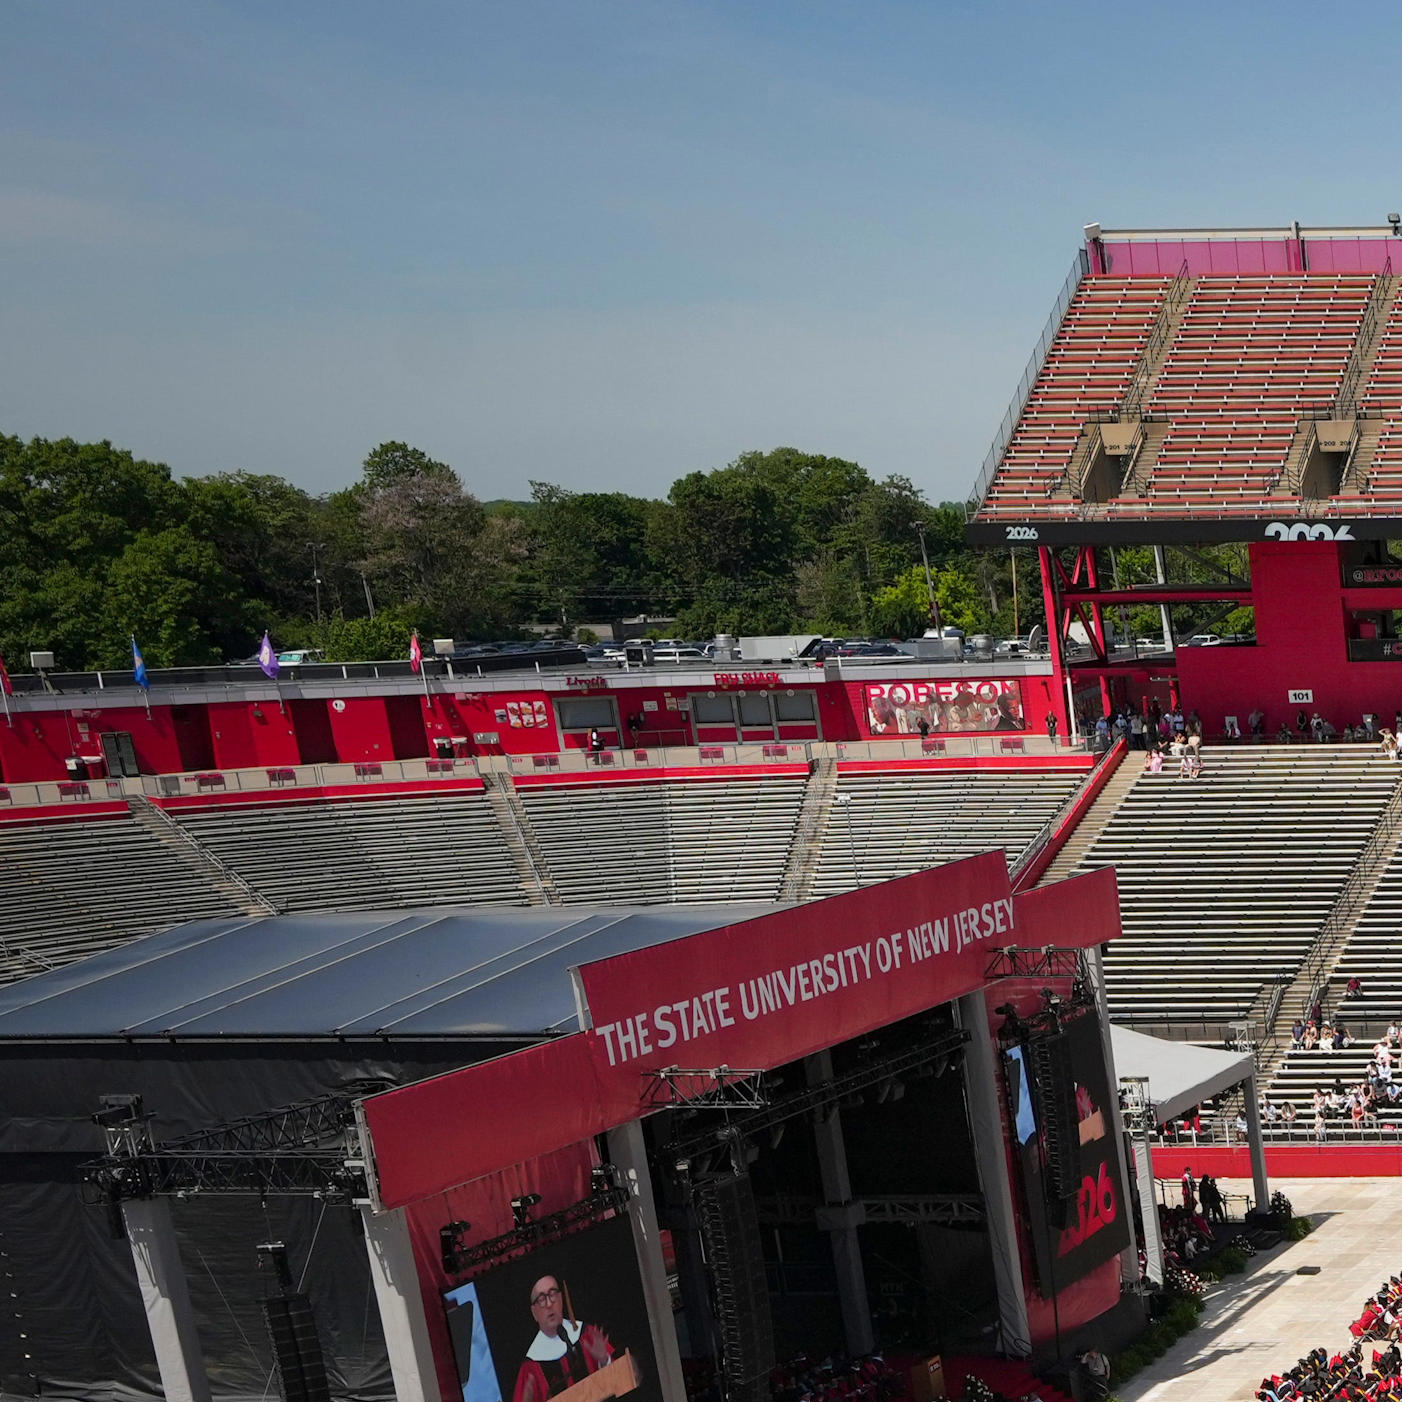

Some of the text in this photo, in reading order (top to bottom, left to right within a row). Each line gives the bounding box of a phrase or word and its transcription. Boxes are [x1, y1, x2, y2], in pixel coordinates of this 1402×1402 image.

[1006, 525, 1038, 540] 2026
[1292, 692, 1309, 701] 101
[596, 898, 1016, 1067] THE STATE UNIVERSITY OF NEW JERSEY
[1057, 1162, 1116, 1258] 26
